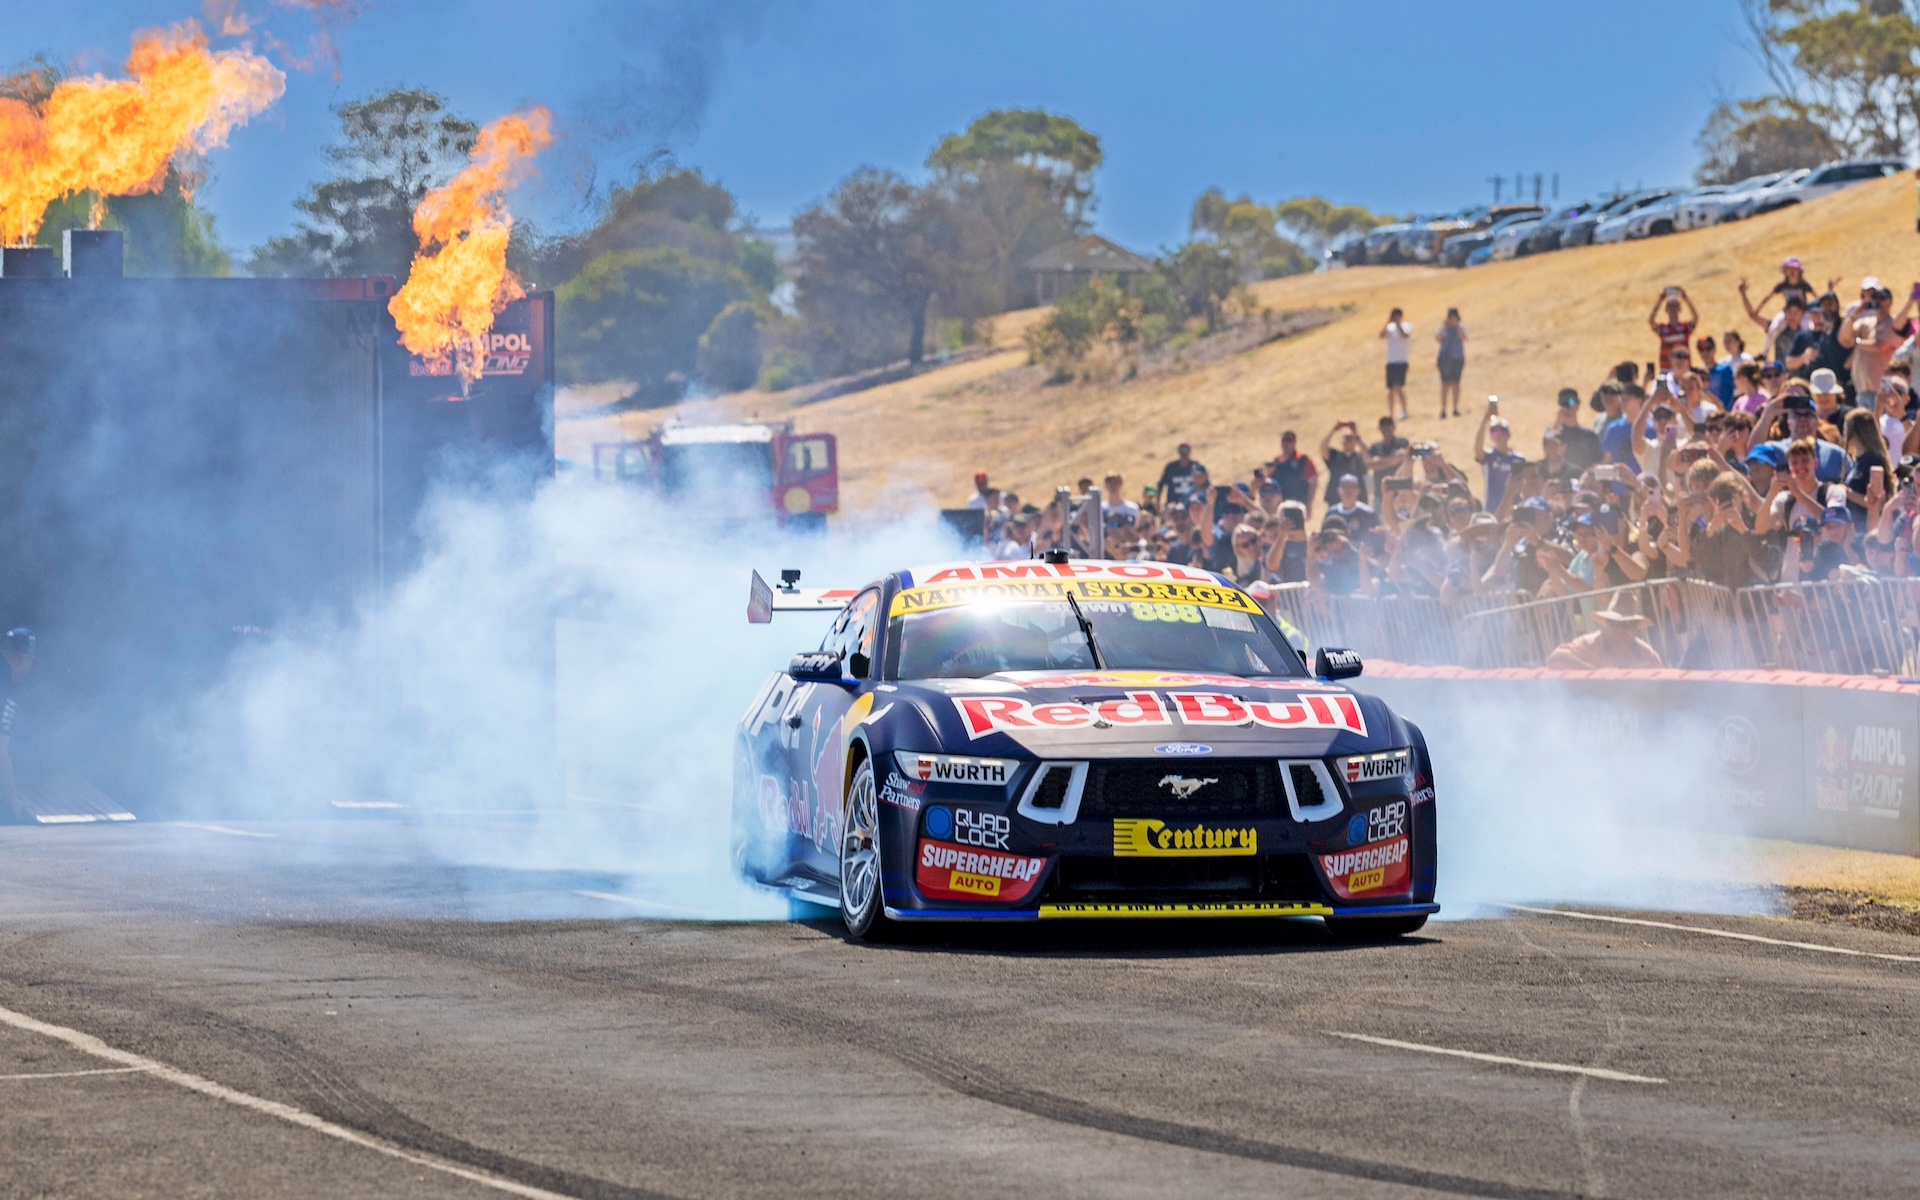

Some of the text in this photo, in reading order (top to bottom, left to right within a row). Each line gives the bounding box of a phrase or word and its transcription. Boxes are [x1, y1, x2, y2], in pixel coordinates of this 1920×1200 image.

[924, 563, 1212, 583] AMPOL
[901, 582, 1242, 609] NATIONAL STORAGE
[1131, 602, 1202, 623] 888
[1850, 725, 1906, 766] AMPOL
[935, 763, 1006, 782] WÜRTH
[1362, 757, 1407, 778] WÜRTH
[886, 772, 911, 791] Shaw
[1850, 772, 1905, 808] RACING
[879, 785, 921, 811] Partners
[956, 809, 1010, 834] QUAD
[1369, 801, 1406, 826] QUAD
[955, 825, 1010, 850] LOCK
[1113, 819, 1257, 856] Century
[1368, 818, 1405, 842] LOCK
[922, 844, 1042, 881] SUPERCHEAP
[1324, 838, 1408, 879] SUPERCHEAP
[955, 876, 995, 891] AUTO
[1352, 872, 1381, 888] AUTO
